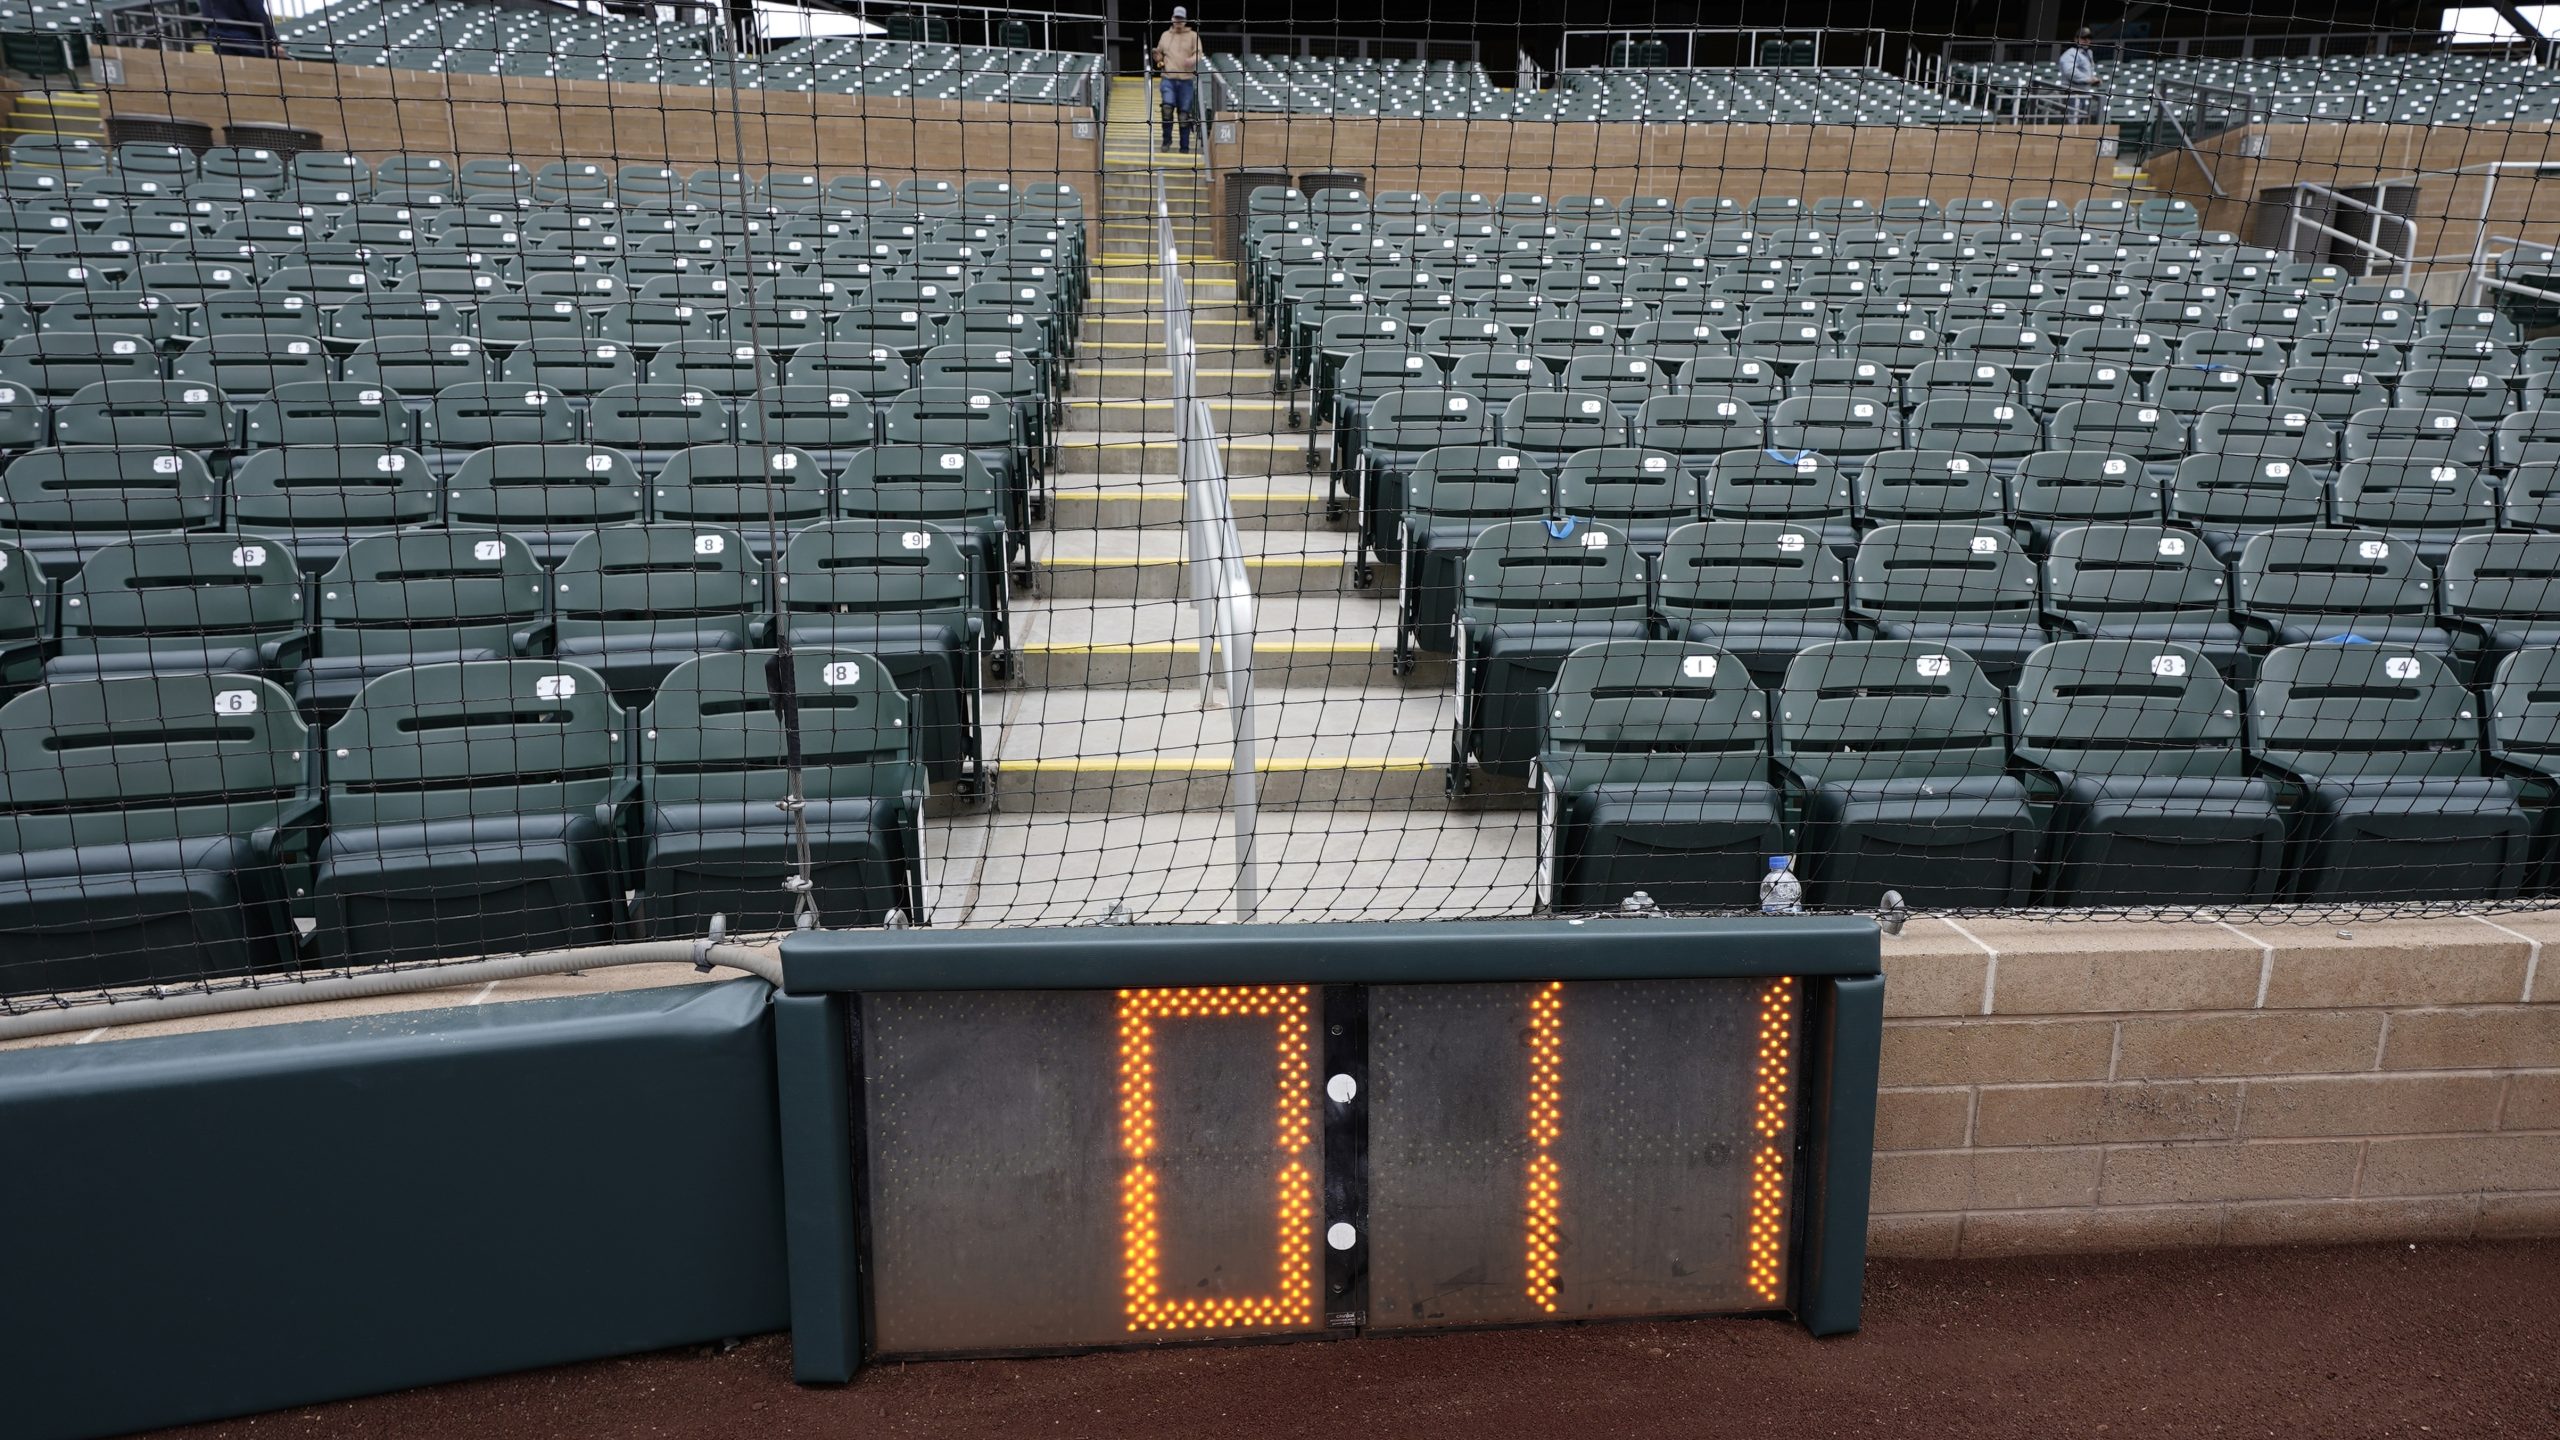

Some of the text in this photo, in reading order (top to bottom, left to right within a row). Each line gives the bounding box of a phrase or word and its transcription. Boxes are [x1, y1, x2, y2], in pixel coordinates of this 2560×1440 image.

[164, 458, 172, 470] 5
[387, 457, 395, 469] 6
[595, 458, 603, 468] 7
[948, 456, 956, 466] 9
[1507, 458, 1510, 467] 1
[1652, 460, 1659, 469] 2
[1802, 461, 1809, 470] 3
[1954, 461, 1961, 470] 4
[2111, 462, 2118, 471] 5
[2274, 465, 2281, 474] 6
[704, 538, 713, 551] 8
[912, 534, 921, 546] 9
[1592, 535, 1597, 546] 1
[1787, 536, 1795, 548] 2
[1979, 539, 1988, 551] 3
[486, 544, 495, 556] 7
[2167, 541, 2175, 552] 4
[2370, 544, 2378, 555] 5
[244, 549, 254, 562] 6
[1698, 659, 1702, 673] 1
[1928, 659, 1938, 672] 2
[2163, 658, 2174, 672] 3
[2397, 661, 2407, 673] 4
[836, 666, 847, 681] 8
[550, 679, 561, 695] 7
[229, 694, 242, 711] 6
